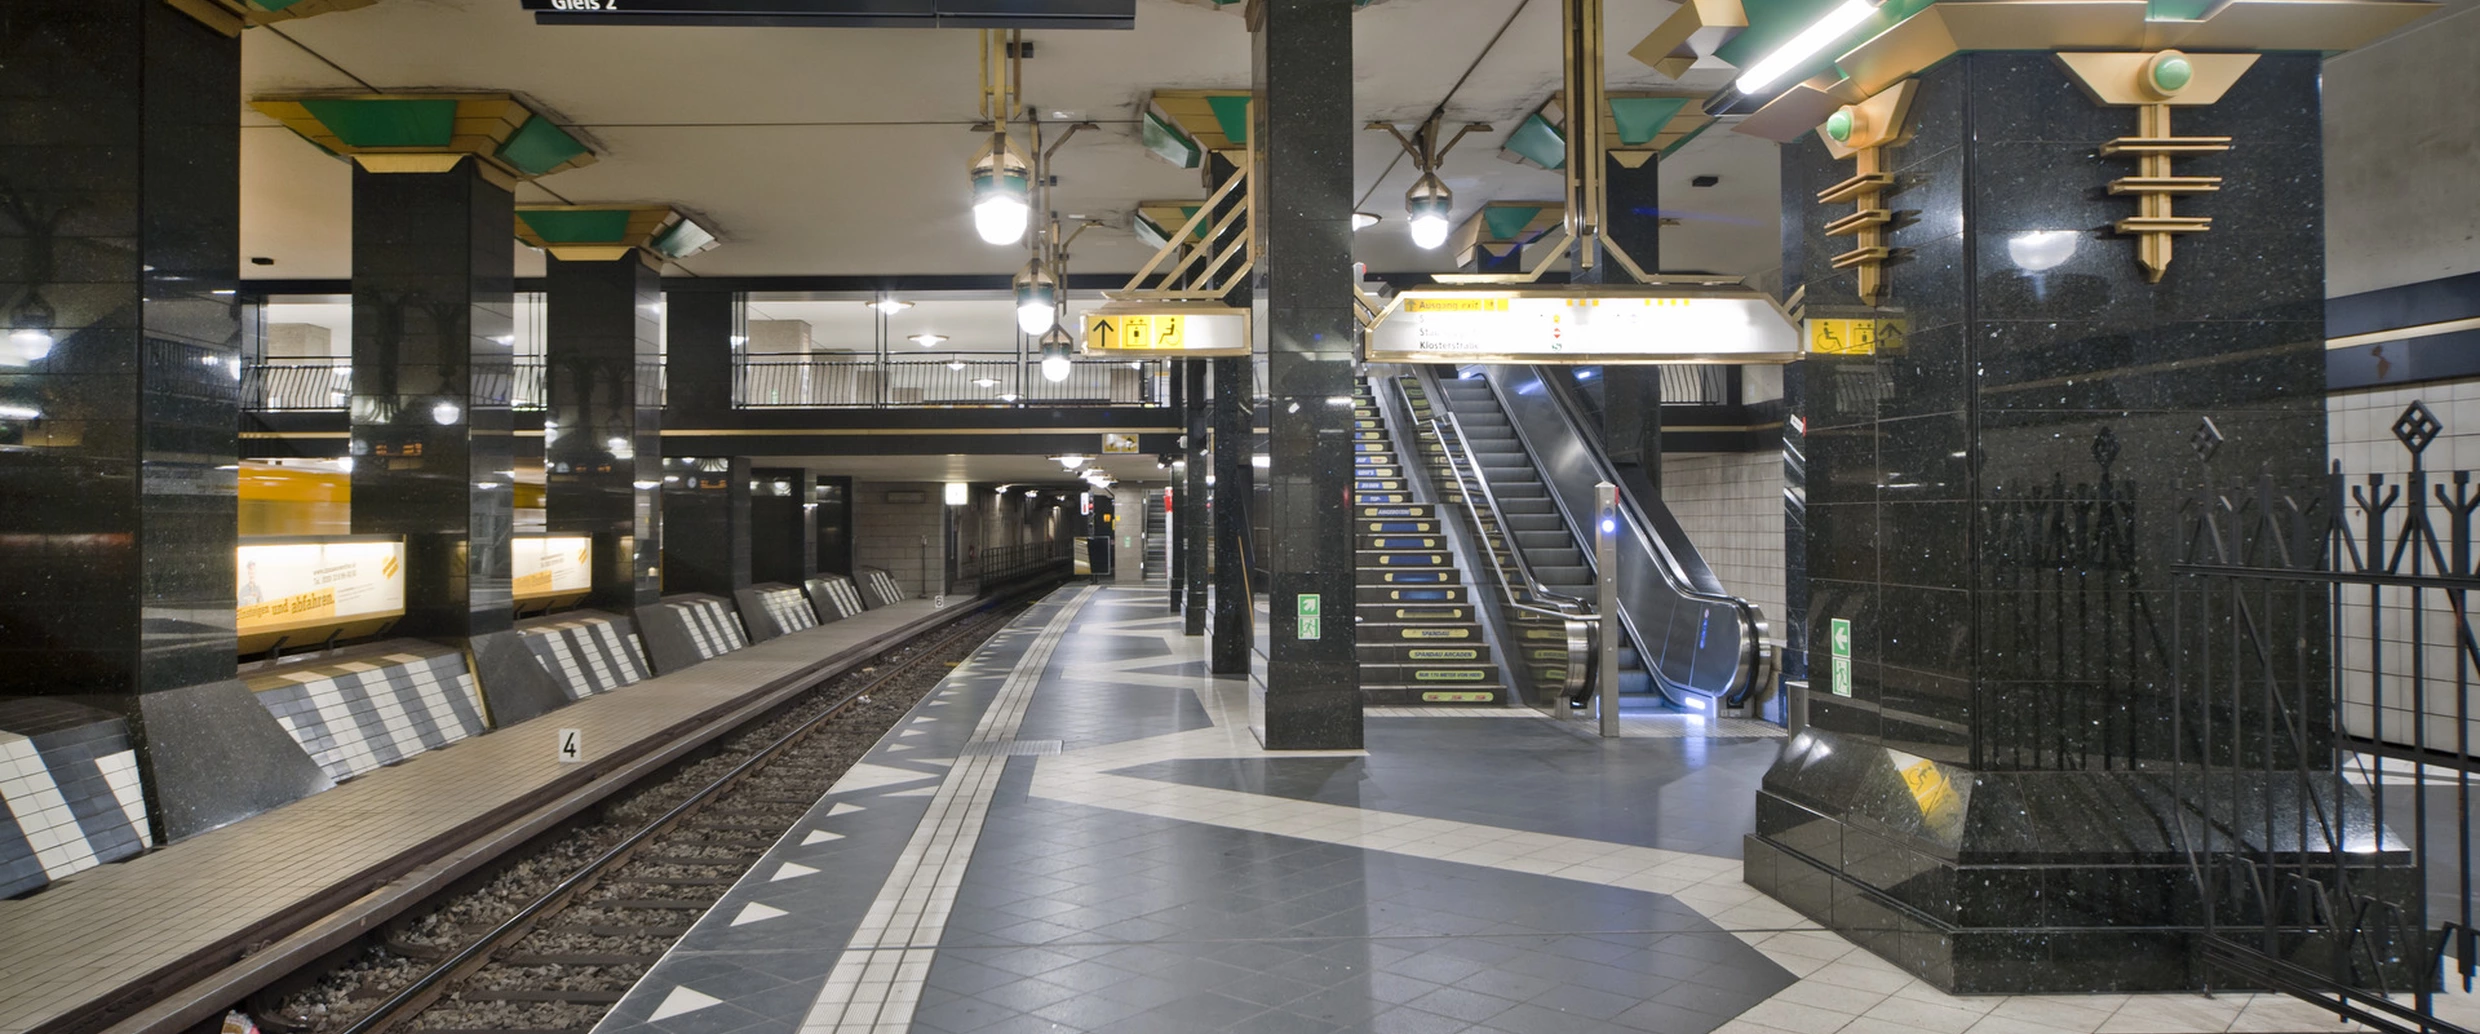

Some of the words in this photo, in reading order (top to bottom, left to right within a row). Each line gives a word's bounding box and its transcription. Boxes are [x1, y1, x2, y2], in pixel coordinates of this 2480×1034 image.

[551, 0, 601, 10] Gleis
[606, 0, 617, 10] 2
[1419, 300, 1458, 311] Ausgang
[272, 598, 289, 615] und
[291, 593, 335, 614] abfahren.
[935, 597, 943, 607] 6
[562, 731, 577, 758] 4
